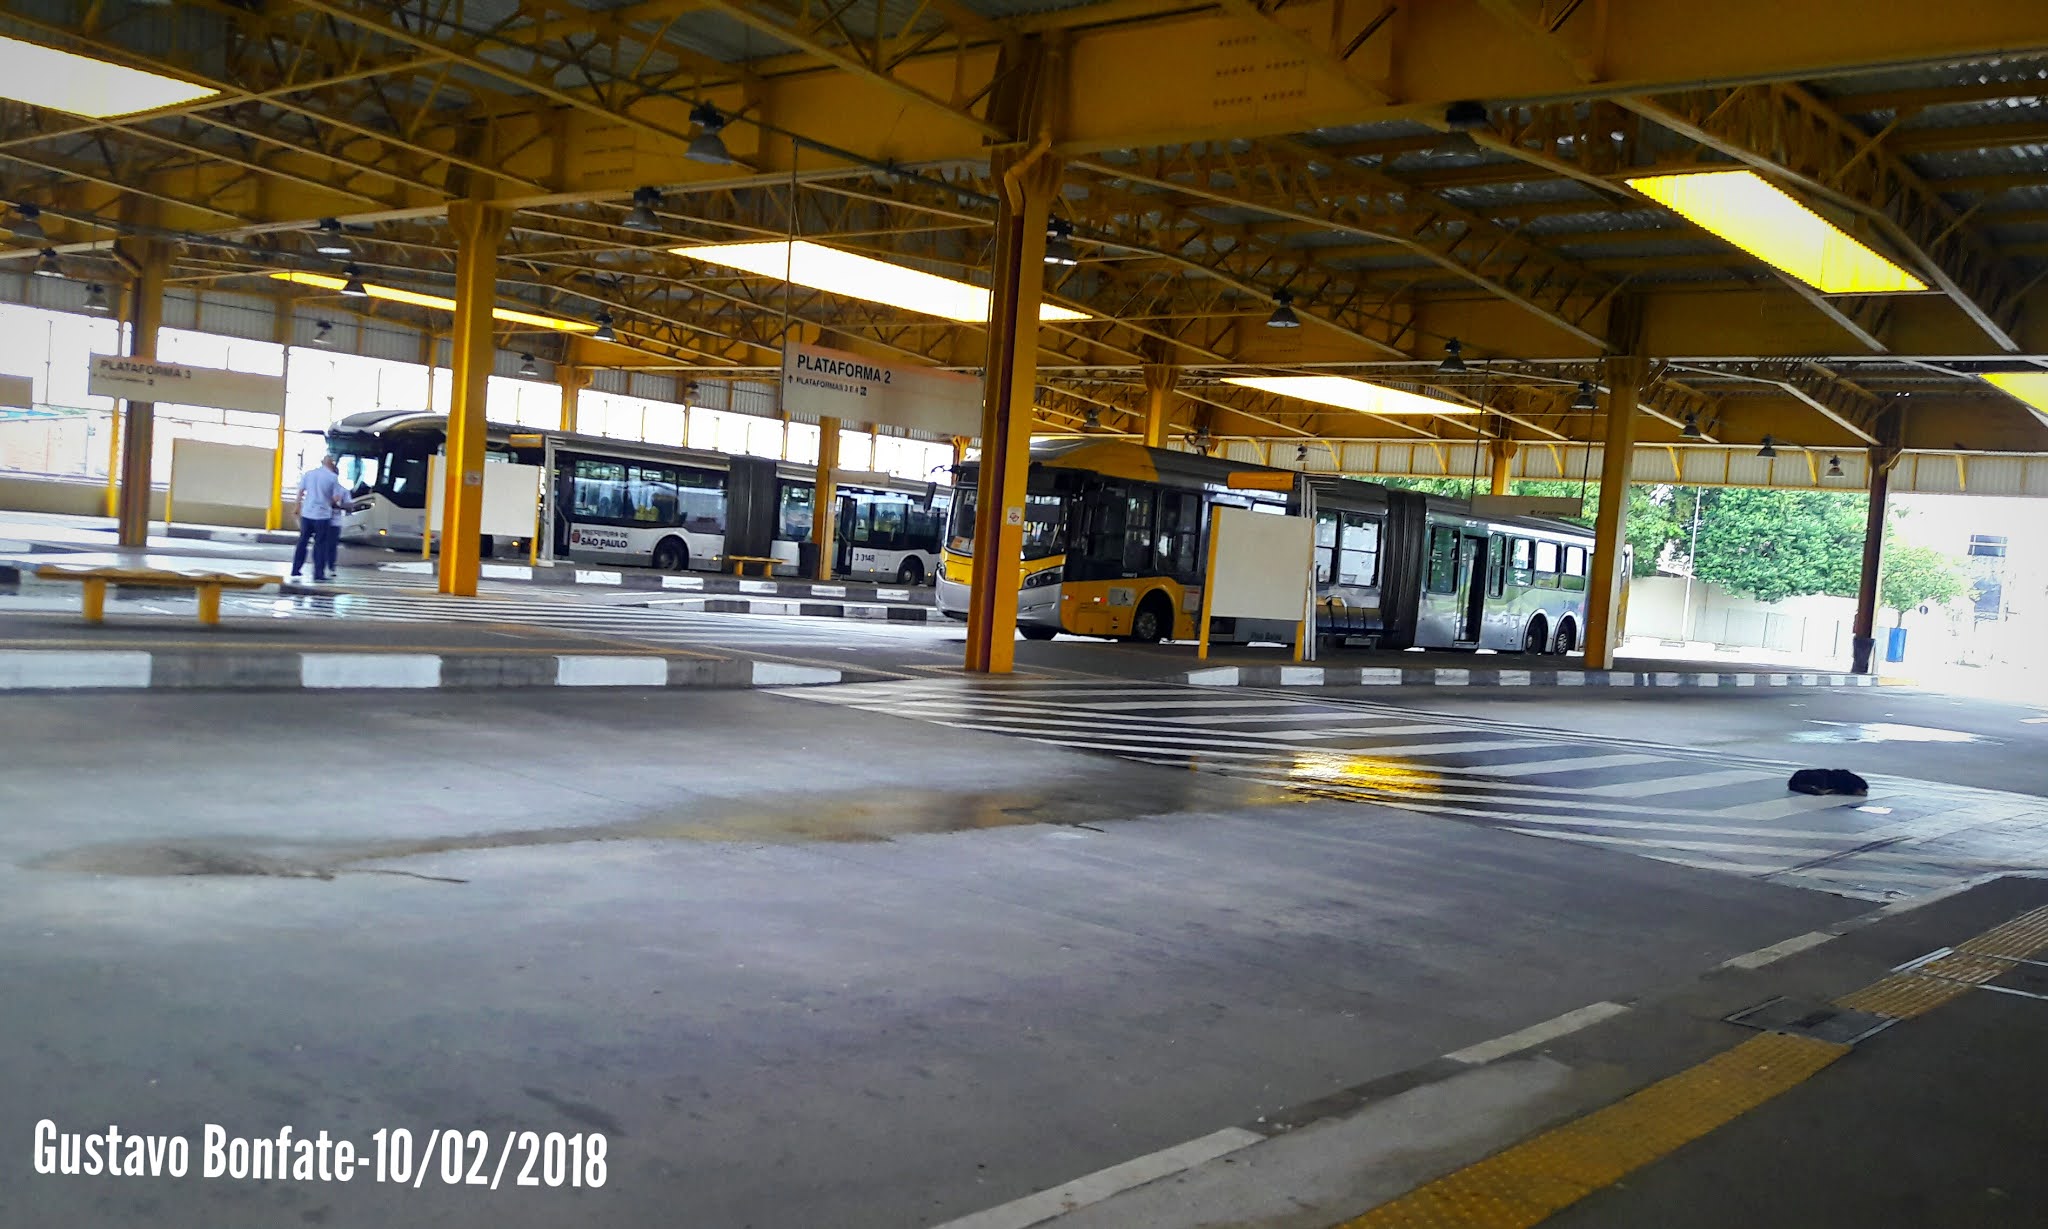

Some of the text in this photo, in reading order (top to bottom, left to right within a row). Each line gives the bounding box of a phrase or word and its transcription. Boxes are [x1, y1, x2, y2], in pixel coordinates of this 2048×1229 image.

[100, 359, 192, 379] PLATAFORMA 3
[797, 354, 891, 384] PLATAFORMA 2
[600, 539, 628, 548] PAULO
